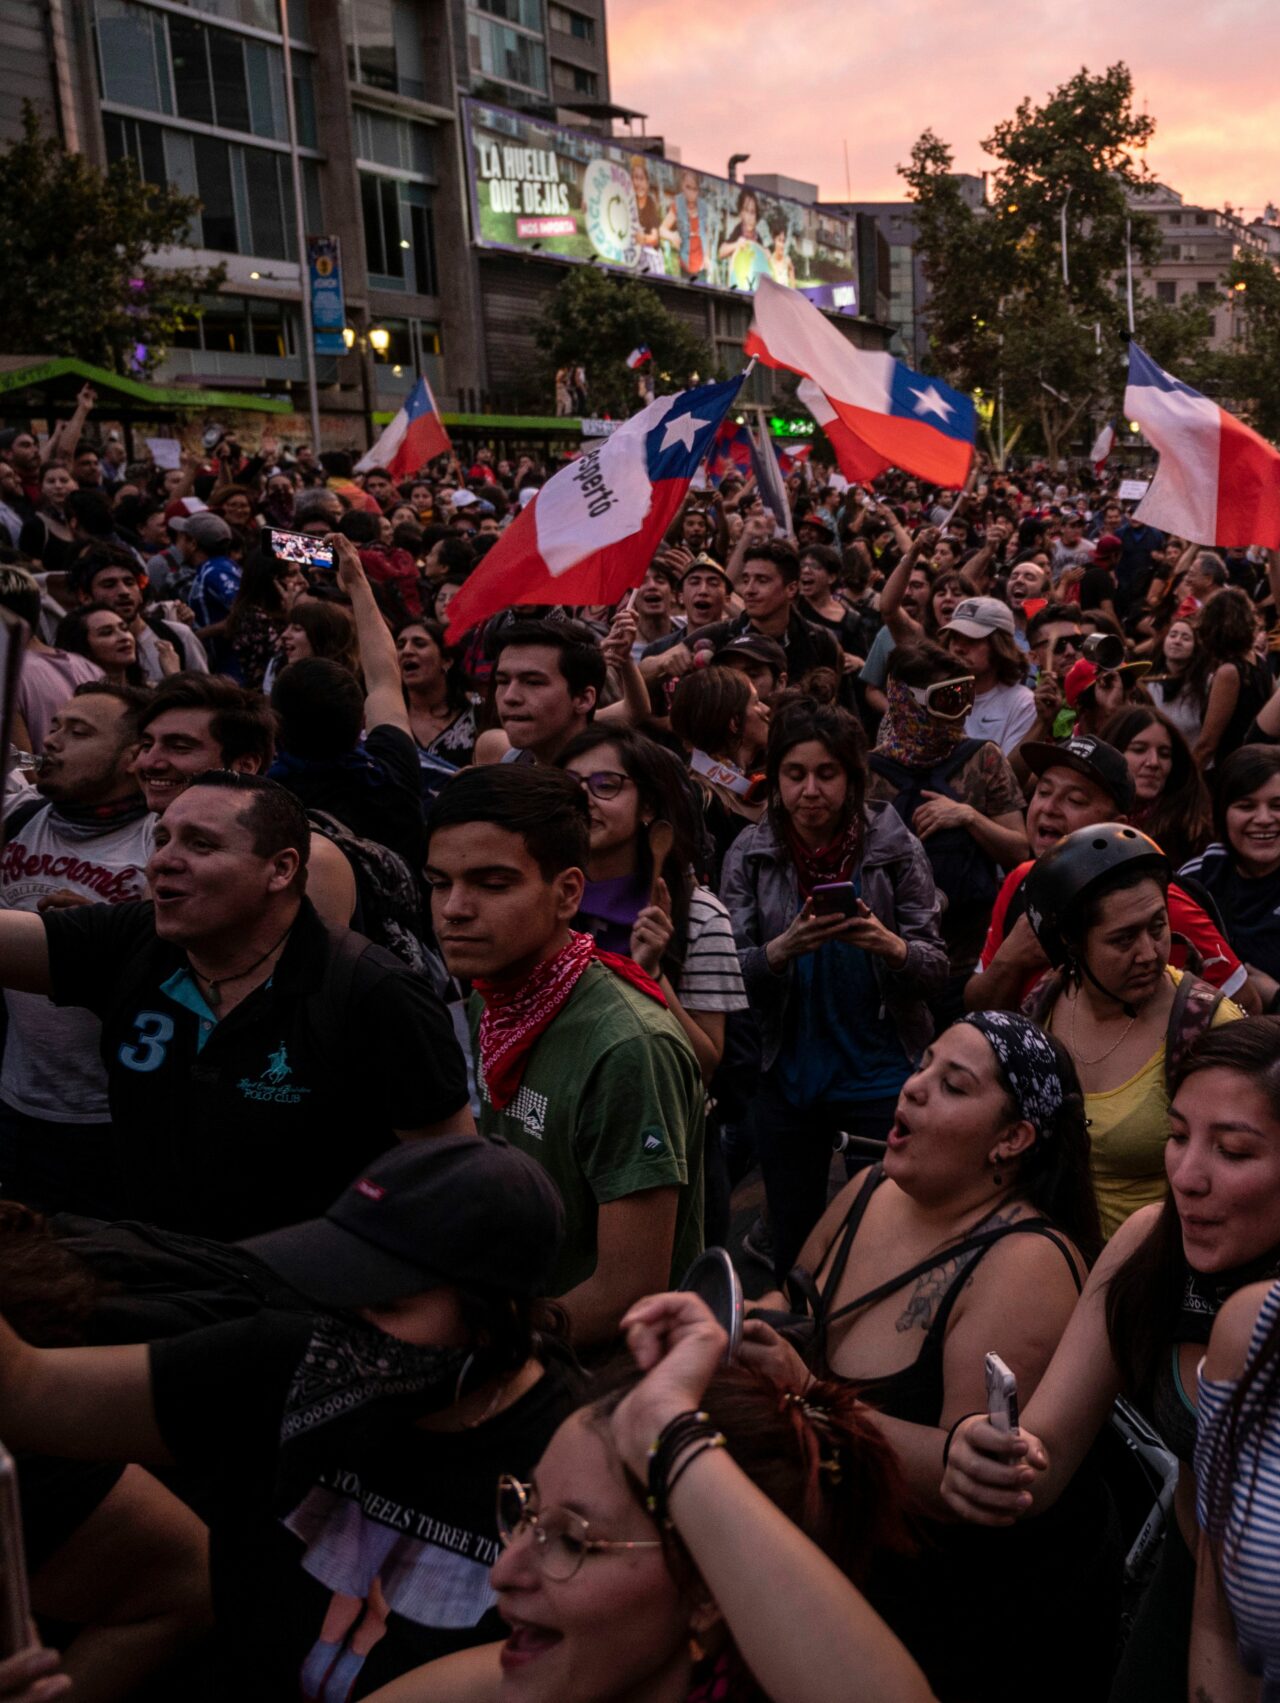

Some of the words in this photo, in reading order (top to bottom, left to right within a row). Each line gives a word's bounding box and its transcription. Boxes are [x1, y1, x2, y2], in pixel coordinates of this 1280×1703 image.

[480, 144, 502, 178] LA
[503, 146, 560, 182] HUELLA
[488, 179, 522, 213] QUE
[524, 181, 570, 216] DEJAS
[118, 1009, 175, 1073] 3
[243, 1089, 272, 1101] POLO
[274, 1092, 302, 1104] CLUB
[416, 1512, 474, 1553] THREE
